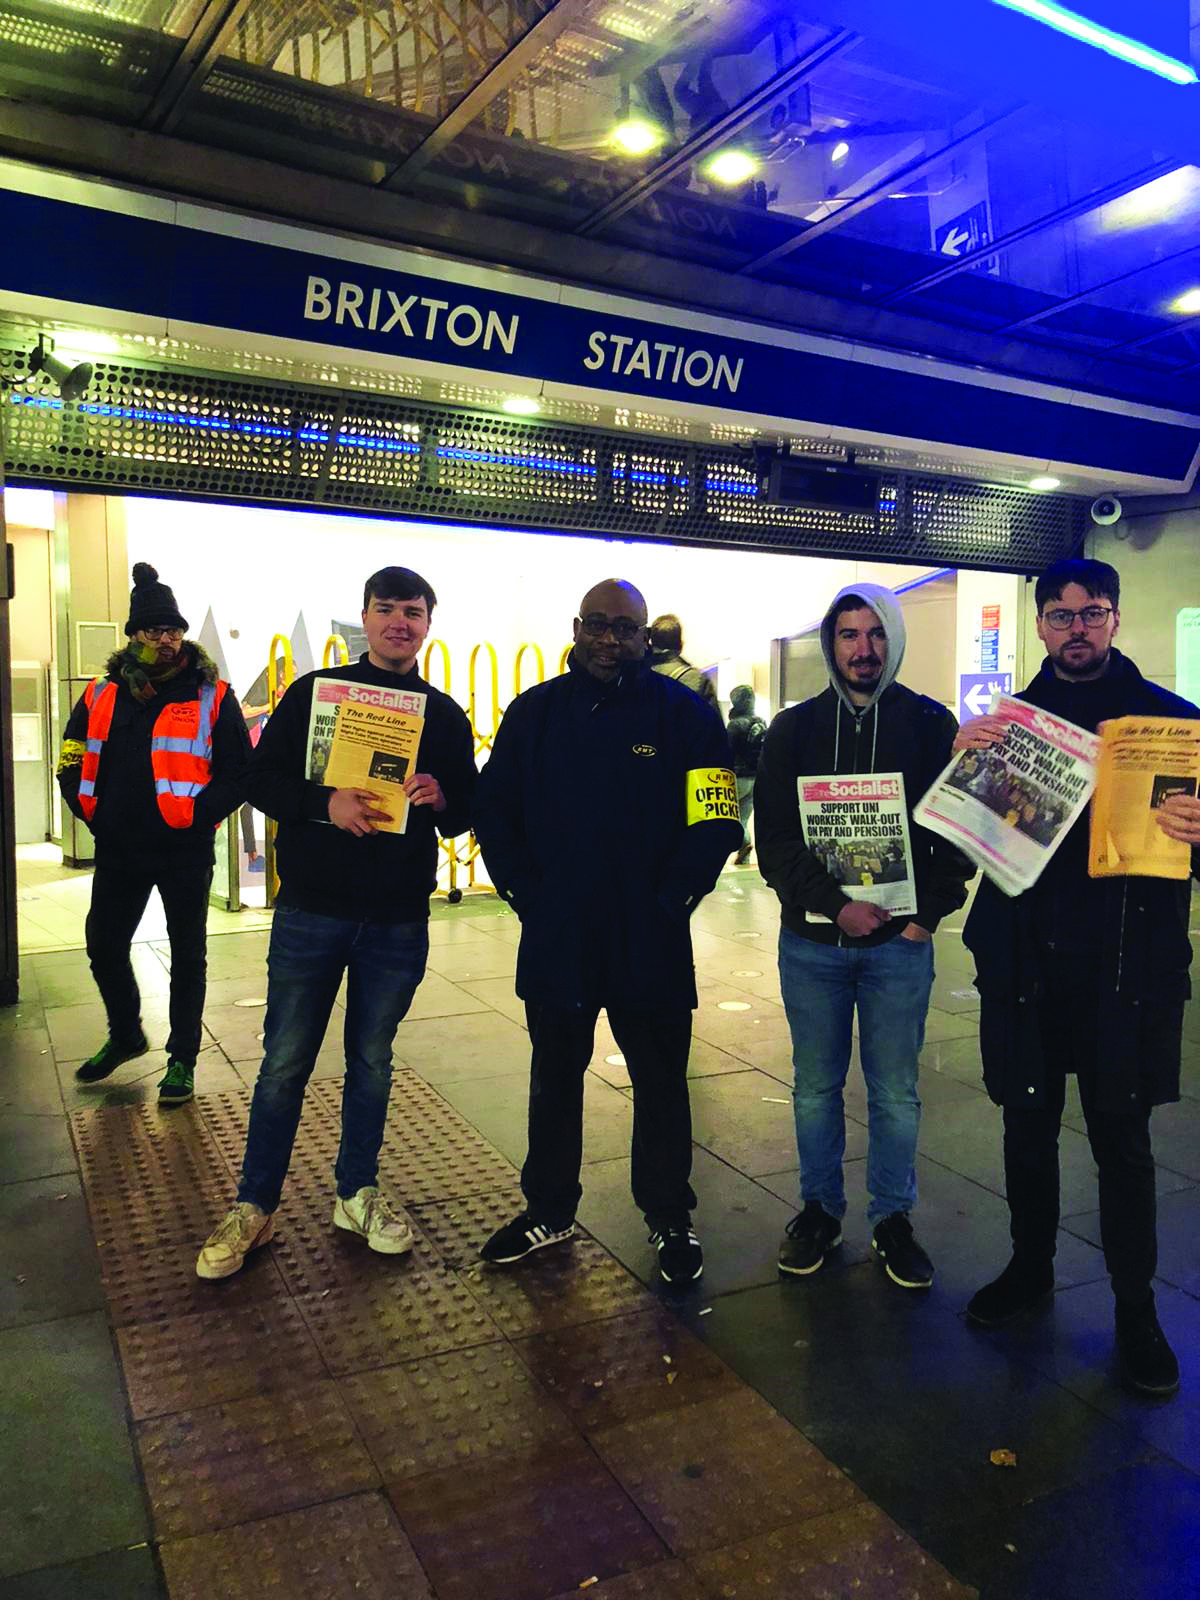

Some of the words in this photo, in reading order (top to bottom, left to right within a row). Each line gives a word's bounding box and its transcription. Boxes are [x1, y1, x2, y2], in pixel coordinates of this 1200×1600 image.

[304, 275, 520, 355] BRIXTON
[583, 330, 744, 393] STATION
[348, 687, 420, 711] Socialist
[346, 708, 364, 718] The
[365, 712, 384, 722] Red
[386, 715, 407, 727] Line
[314, 726, 325, 737] ON
[1007, 722, 1056, 759] SUPPORT
[1055, 749, 1076, 769] UNI
[1003, 734, 1034, 760] KERS'
[1033, 751, 1089, 791] WALK-OUT
[1007, 752, 1030, 773] AND
[1028, 763, 1082, 804] PENSIONS
[695, 786, 737, 803] OFFIC
[829, 779, 899, 797] Socialist
[820, 802, 860, 814] SUPPORT
[862, 802, 879, 813] UNI
[806, 815, 848, 826] WORKERS'
[850, 813, 900, 825] WALK-OUT
[807, 826, 818, 837] ON
[819, 826, 834, 837] PAY
[834, 825, 852, 837] AND
[854, 825, 903, 837] PENSIONS
